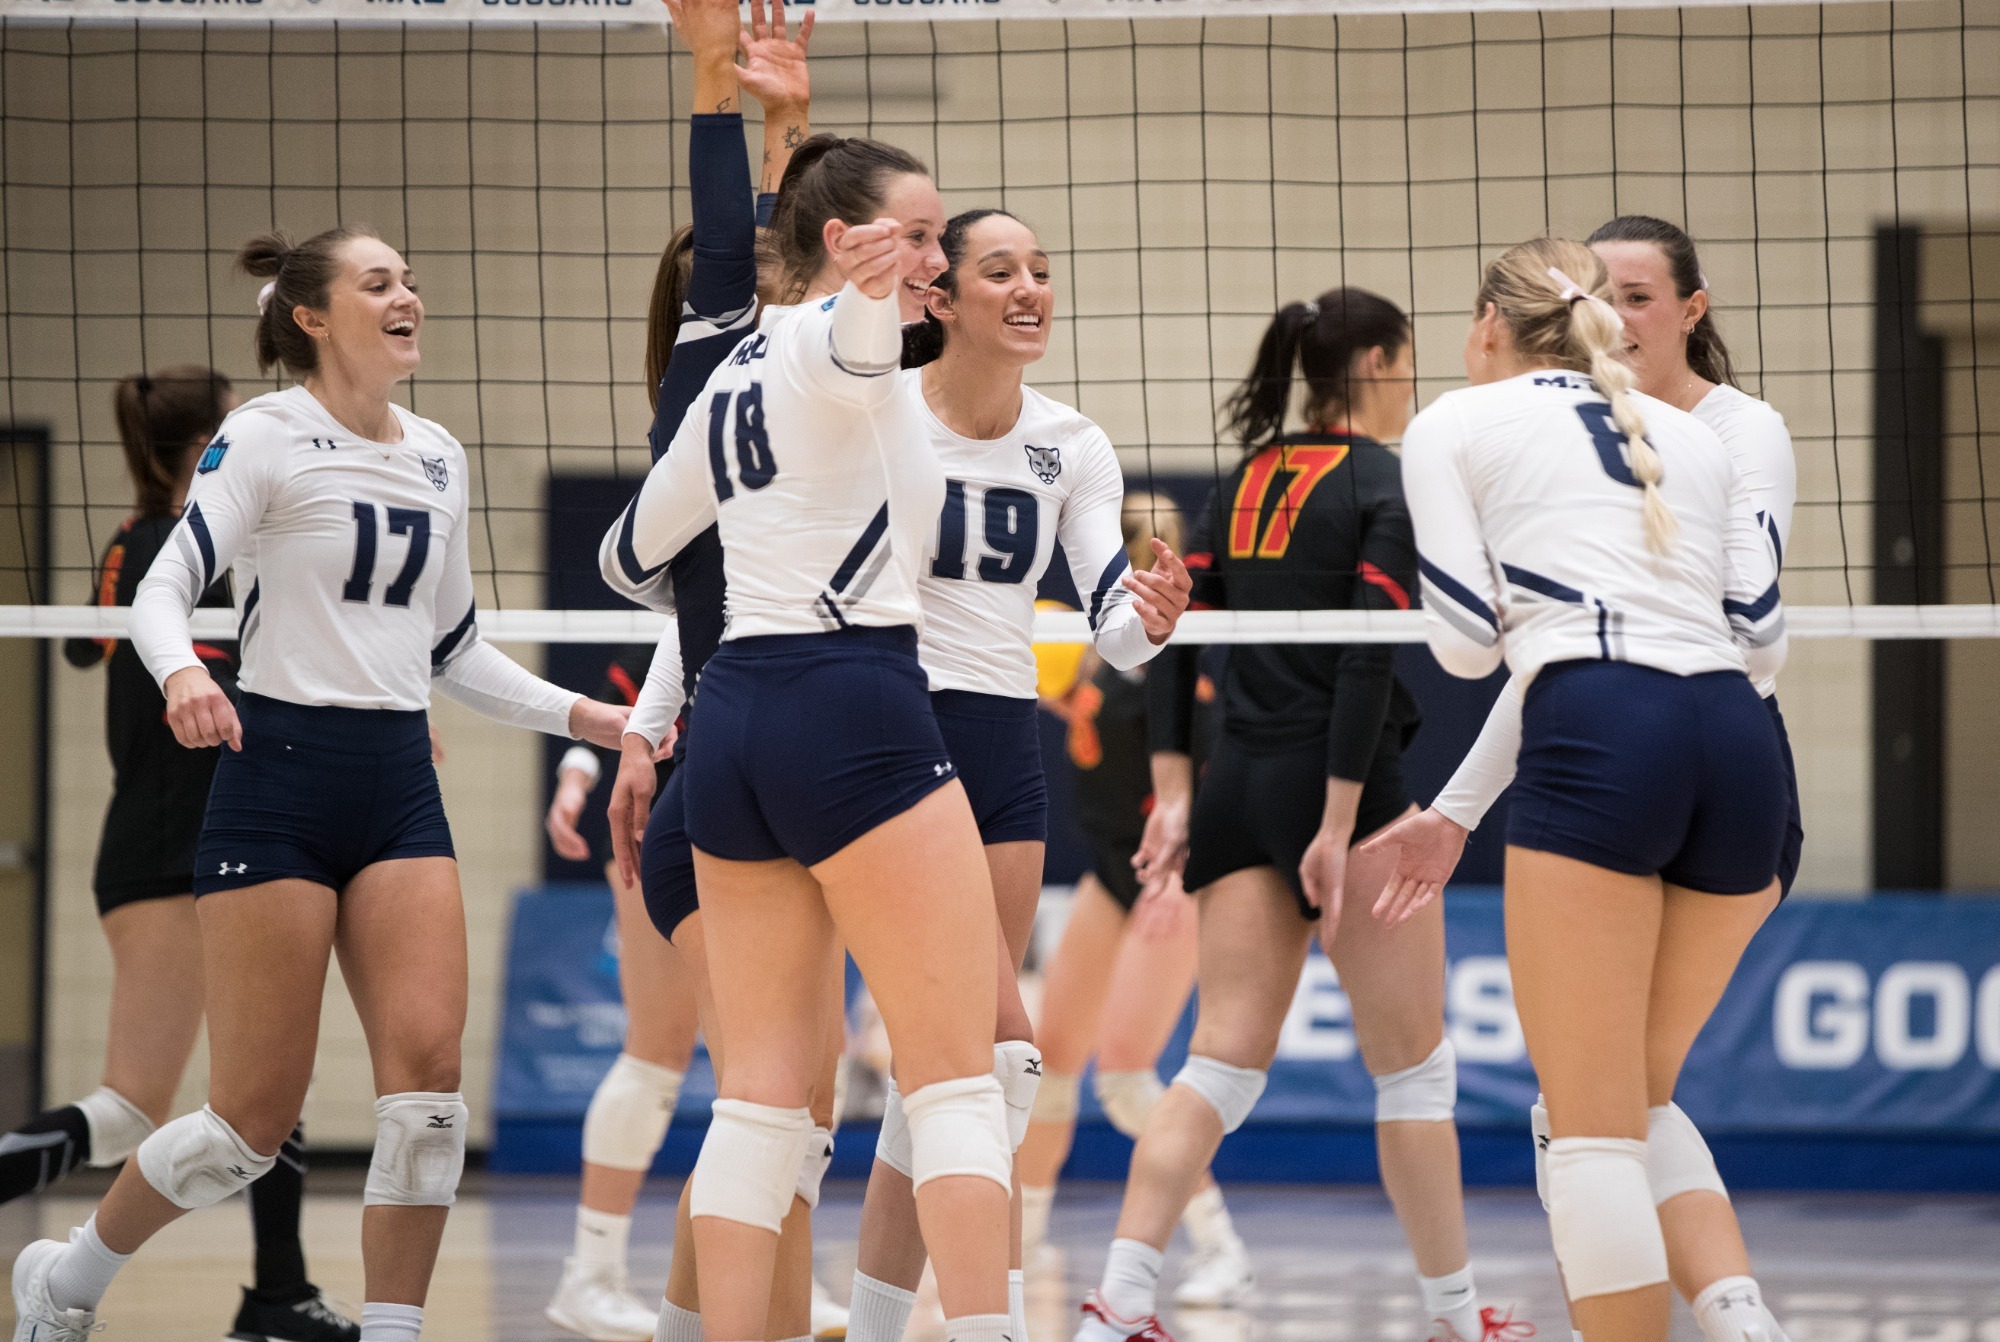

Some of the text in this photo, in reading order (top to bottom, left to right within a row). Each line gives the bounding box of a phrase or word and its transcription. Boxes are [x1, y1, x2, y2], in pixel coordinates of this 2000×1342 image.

[708, 380, 779, 506] 18
[341, 498, 431, 609] 17
[928, 478, 1040, 584] 19
[1229, 444, 1350, 558] 17
[1773, 959, 2000, 1071] GO
